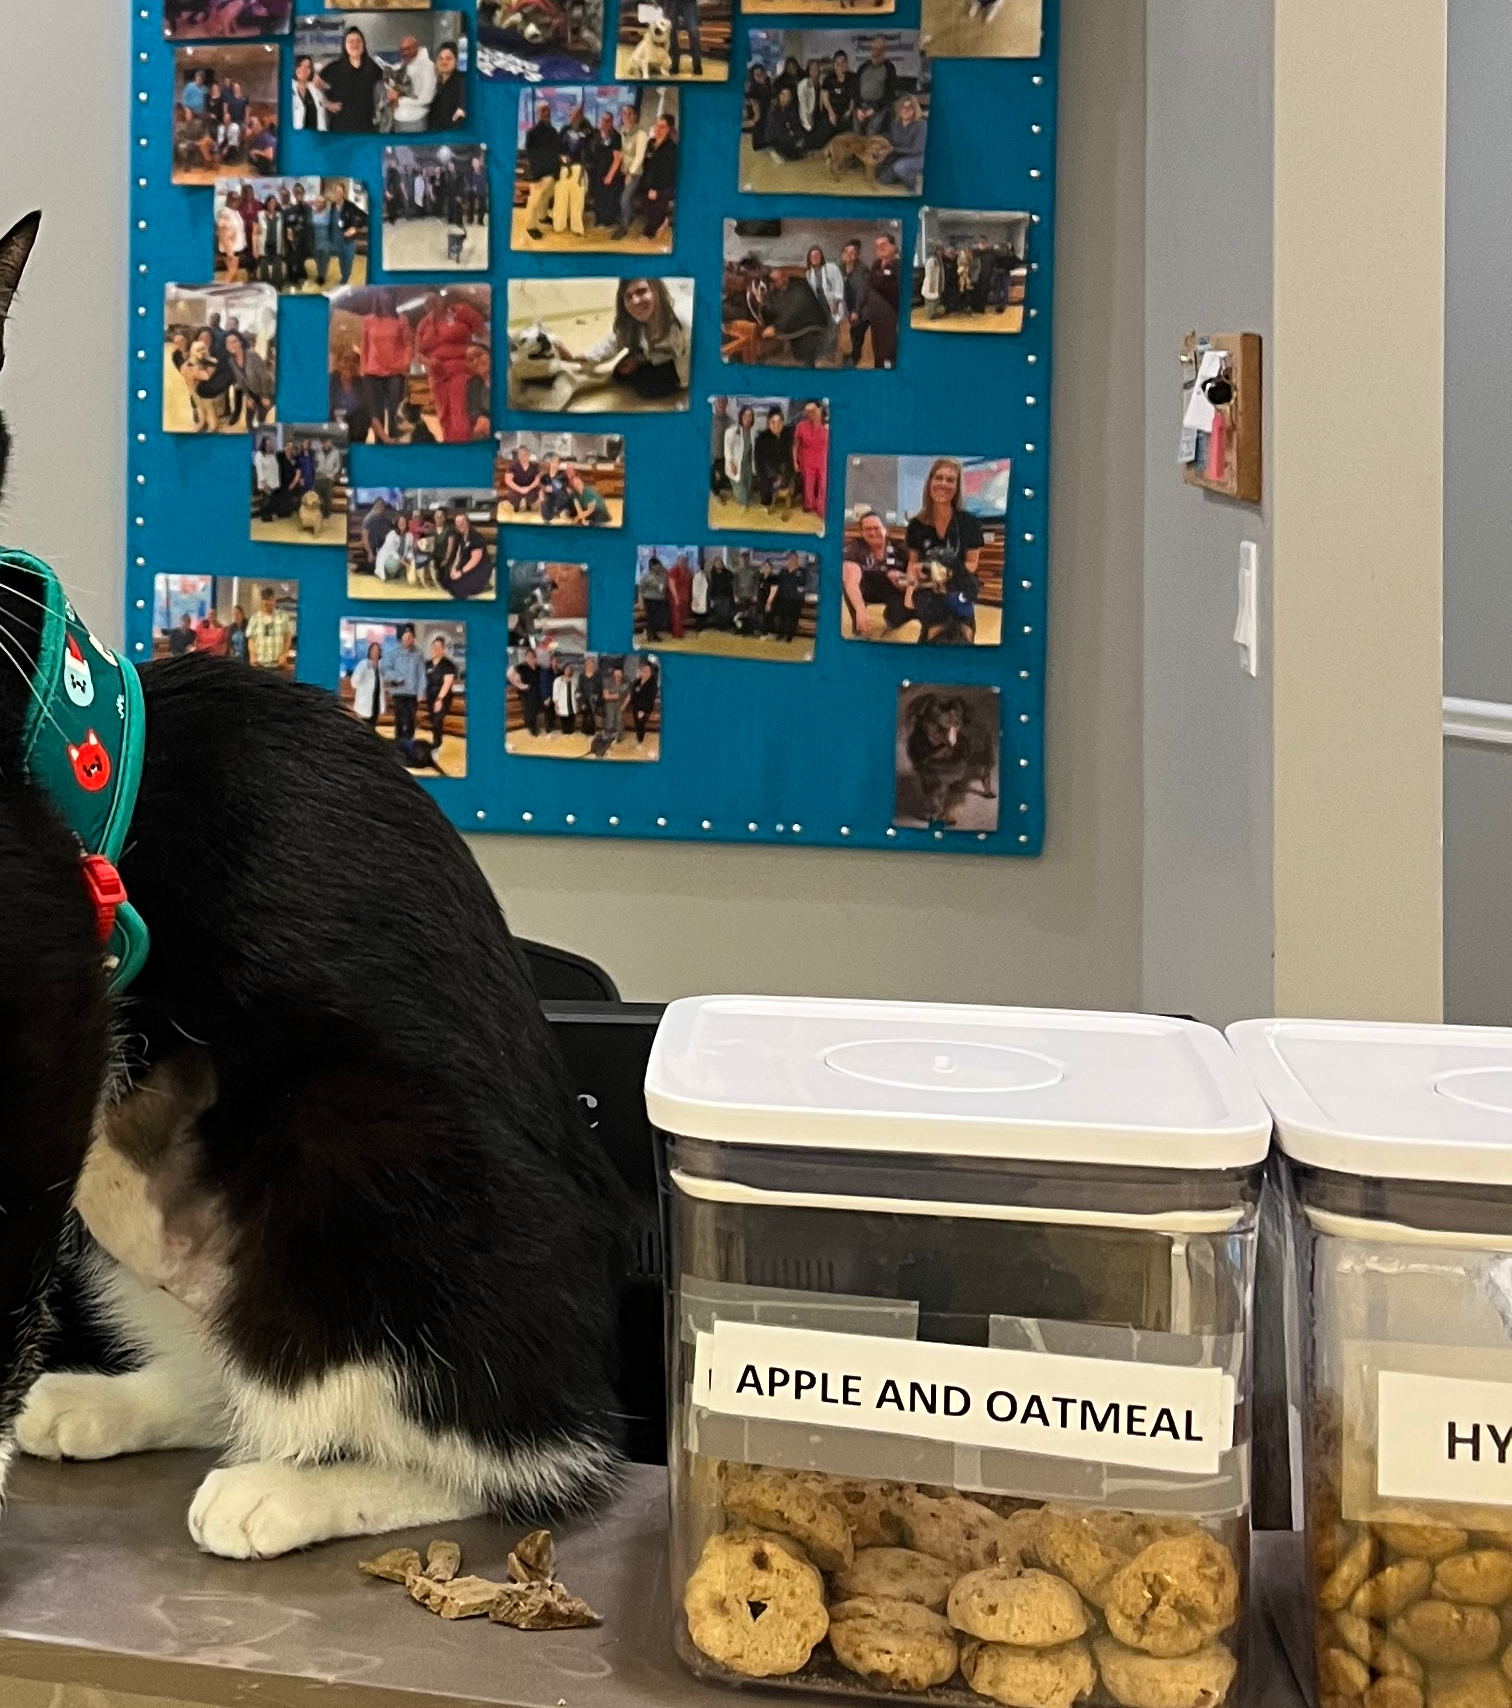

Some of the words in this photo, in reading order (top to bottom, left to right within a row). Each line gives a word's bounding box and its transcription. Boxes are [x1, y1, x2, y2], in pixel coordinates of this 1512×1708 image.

[736, 1364, 862, 1407] APPLE
[876, 1379, 972, 1417] AND
[986, 1390, 1204, 1442] OATMEAL
[1446, 1421, 1512, 1464] HY
